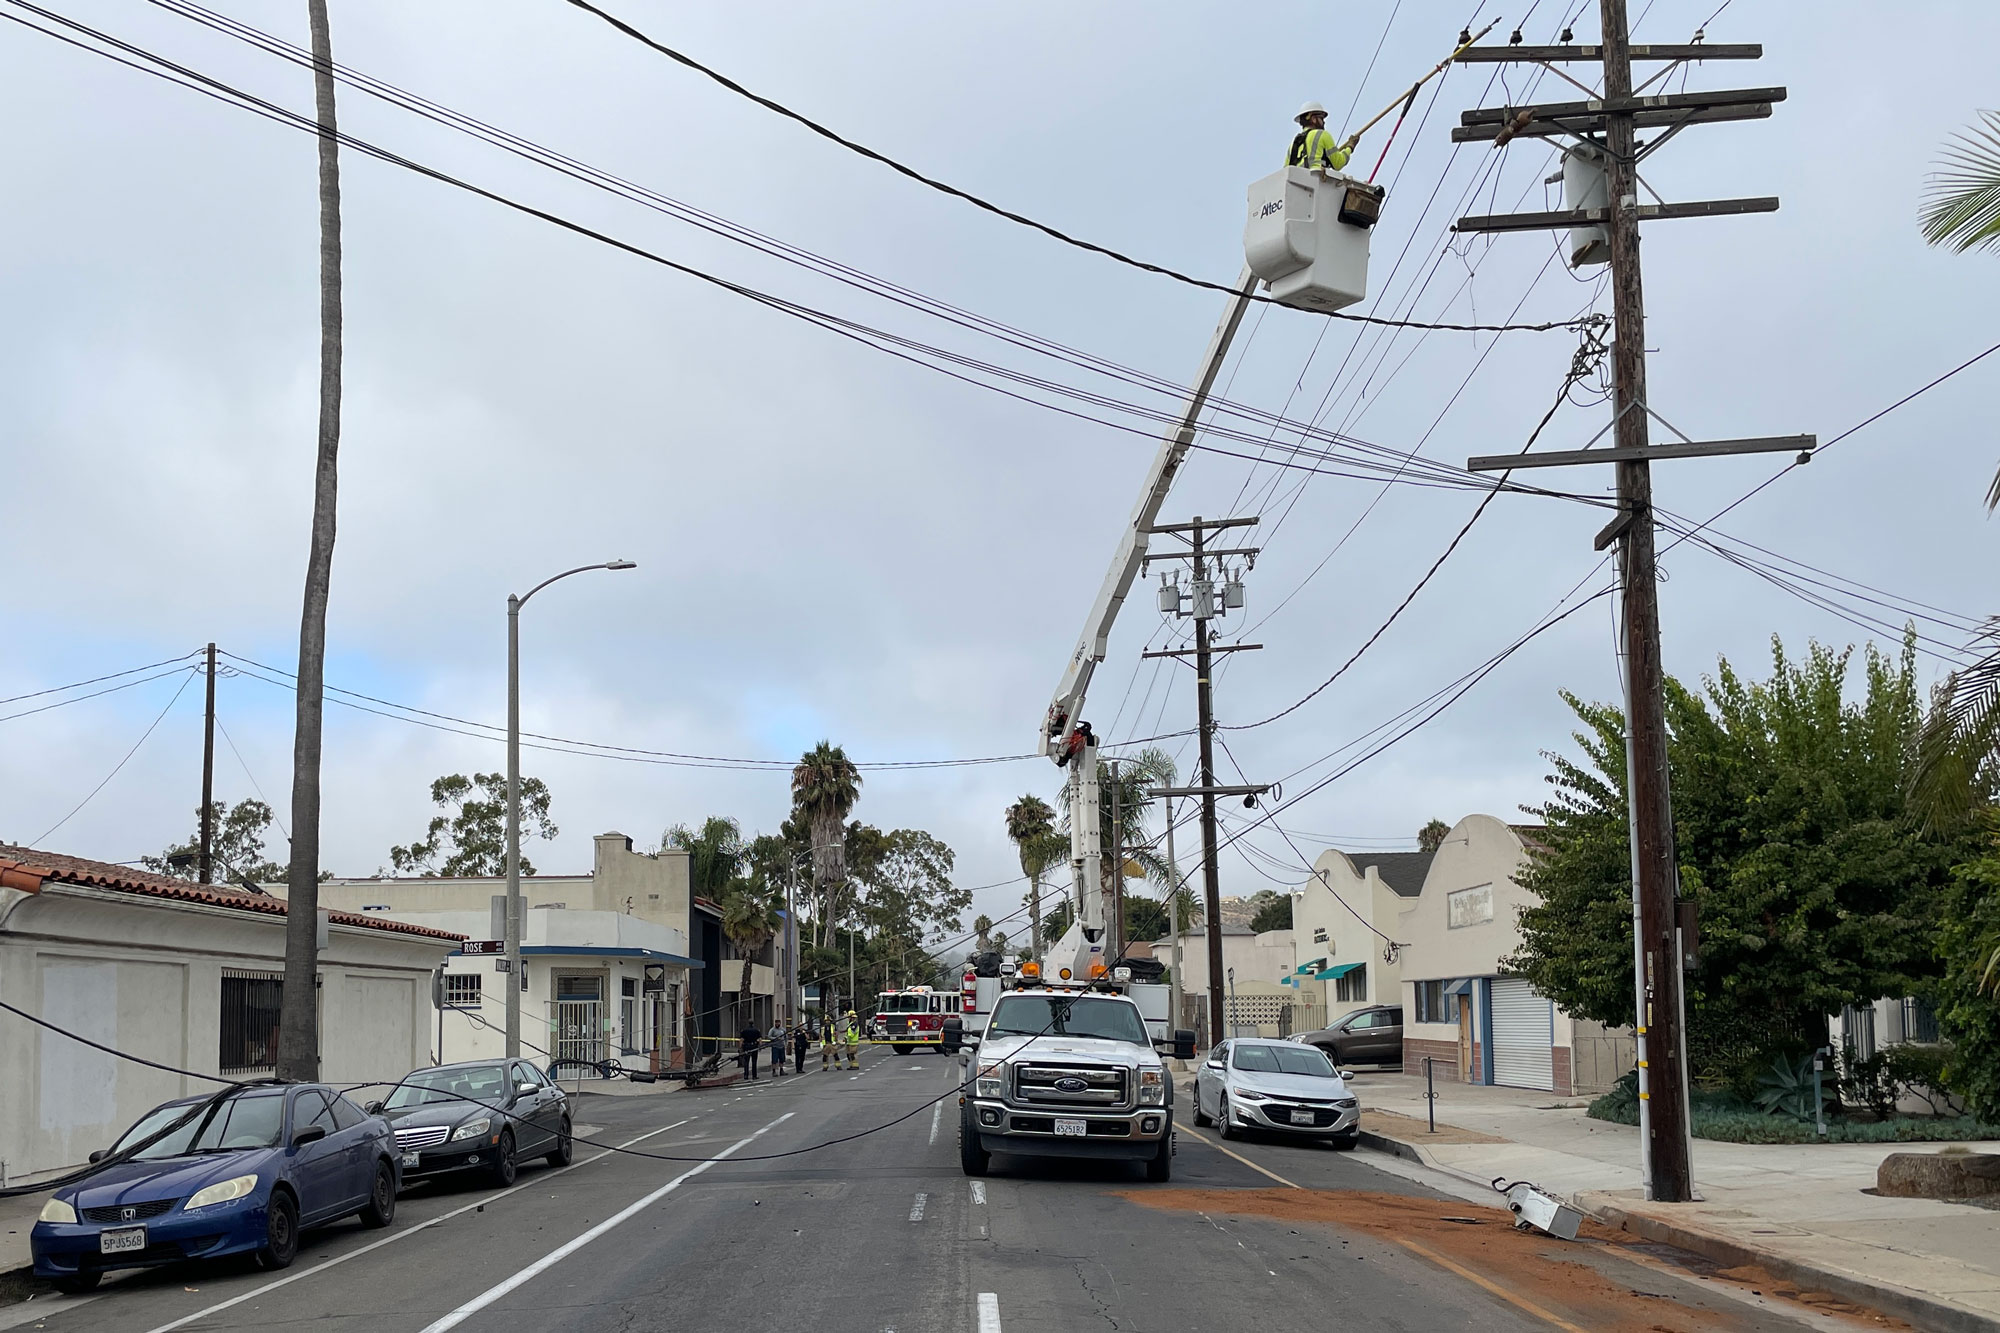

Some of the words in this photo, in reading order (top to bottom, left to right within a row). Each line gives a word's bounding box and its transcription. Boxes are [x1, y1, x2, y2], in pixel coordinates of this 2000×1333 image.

[1260, 200, 1282, 219] Altec
[464, 943, 484, 953] ROSE
[1062, 1080, 1080, 1089] Ford
